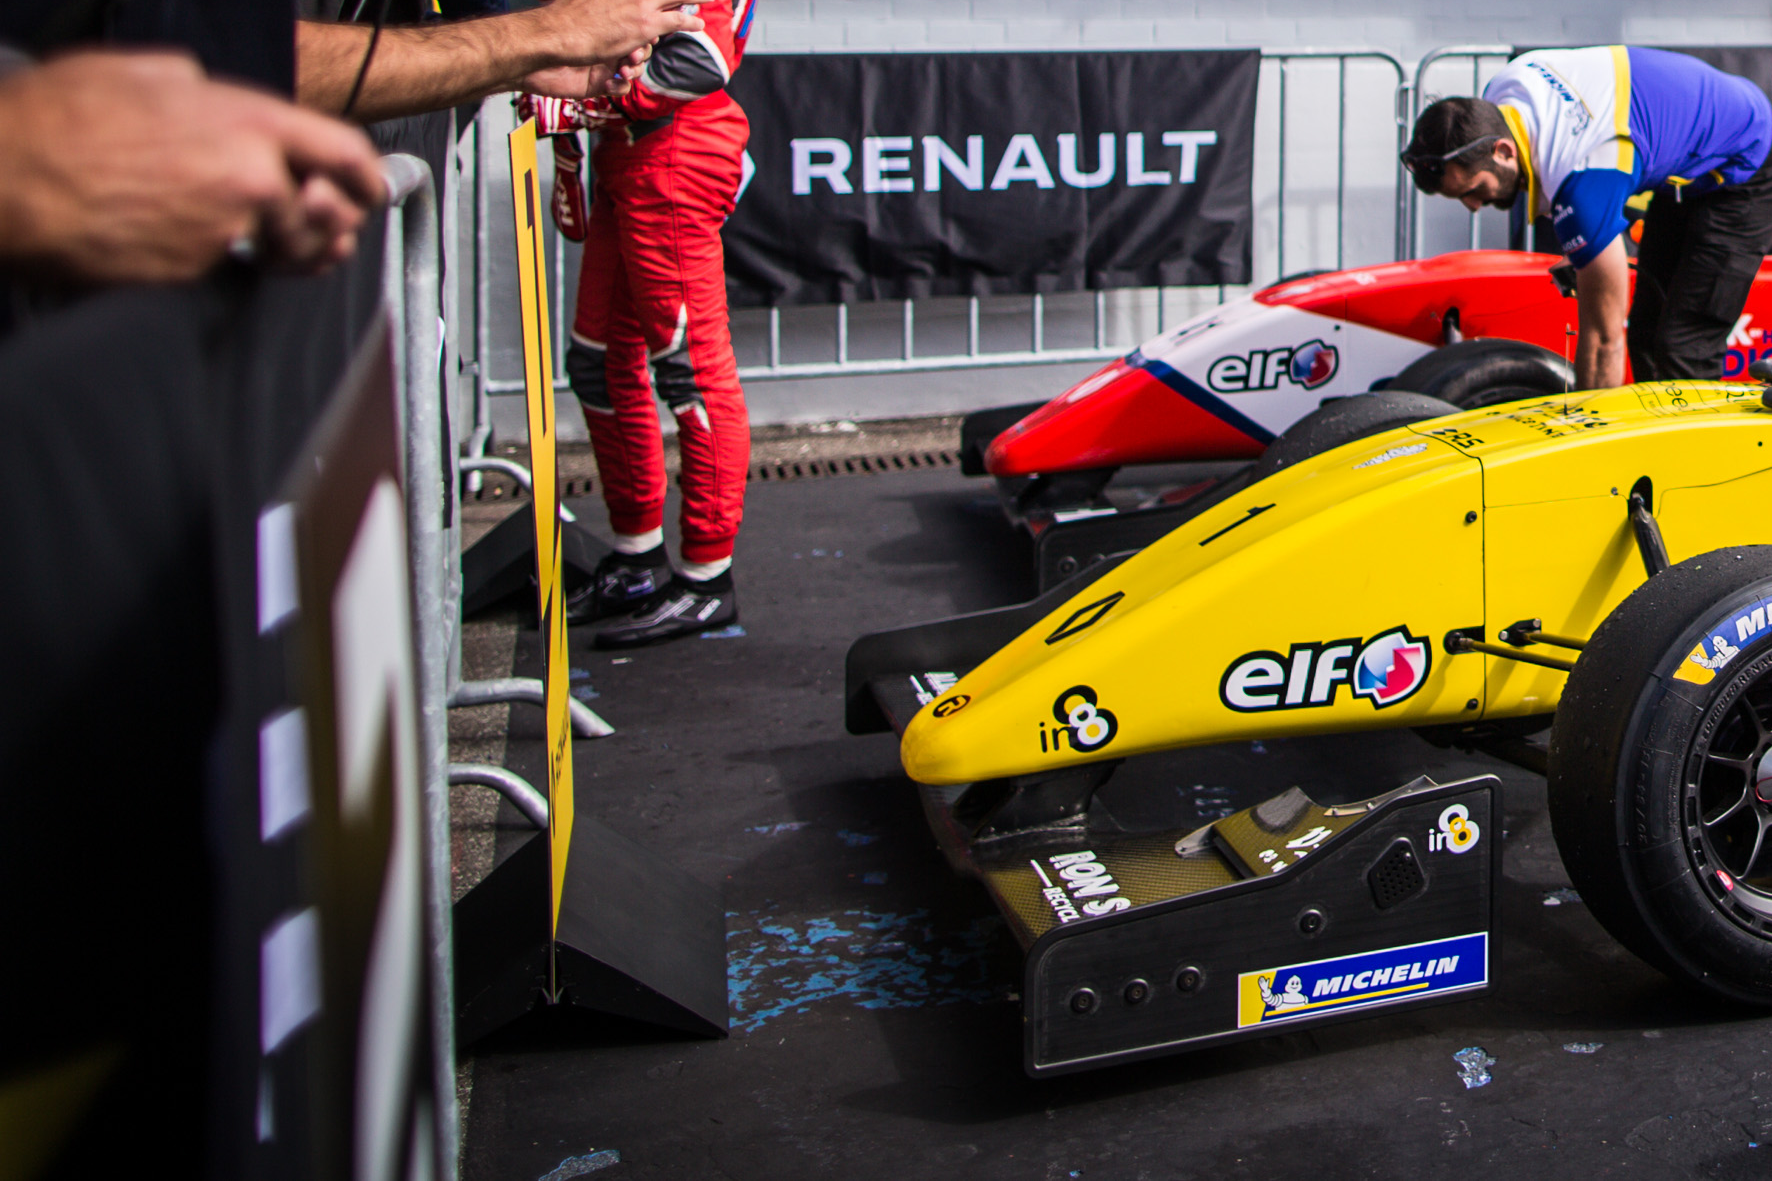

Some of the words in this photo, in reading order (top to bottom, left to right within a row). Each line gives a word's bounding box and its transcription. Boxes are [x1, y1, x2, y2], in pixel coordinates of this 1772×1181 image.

[790, 130, 1217, 196] RENAULT
[1207, 347, 1297, 393] elf
[1222, 643, 1356, 710] elf
[1311, 954, 1460, 999] MICHELIN
